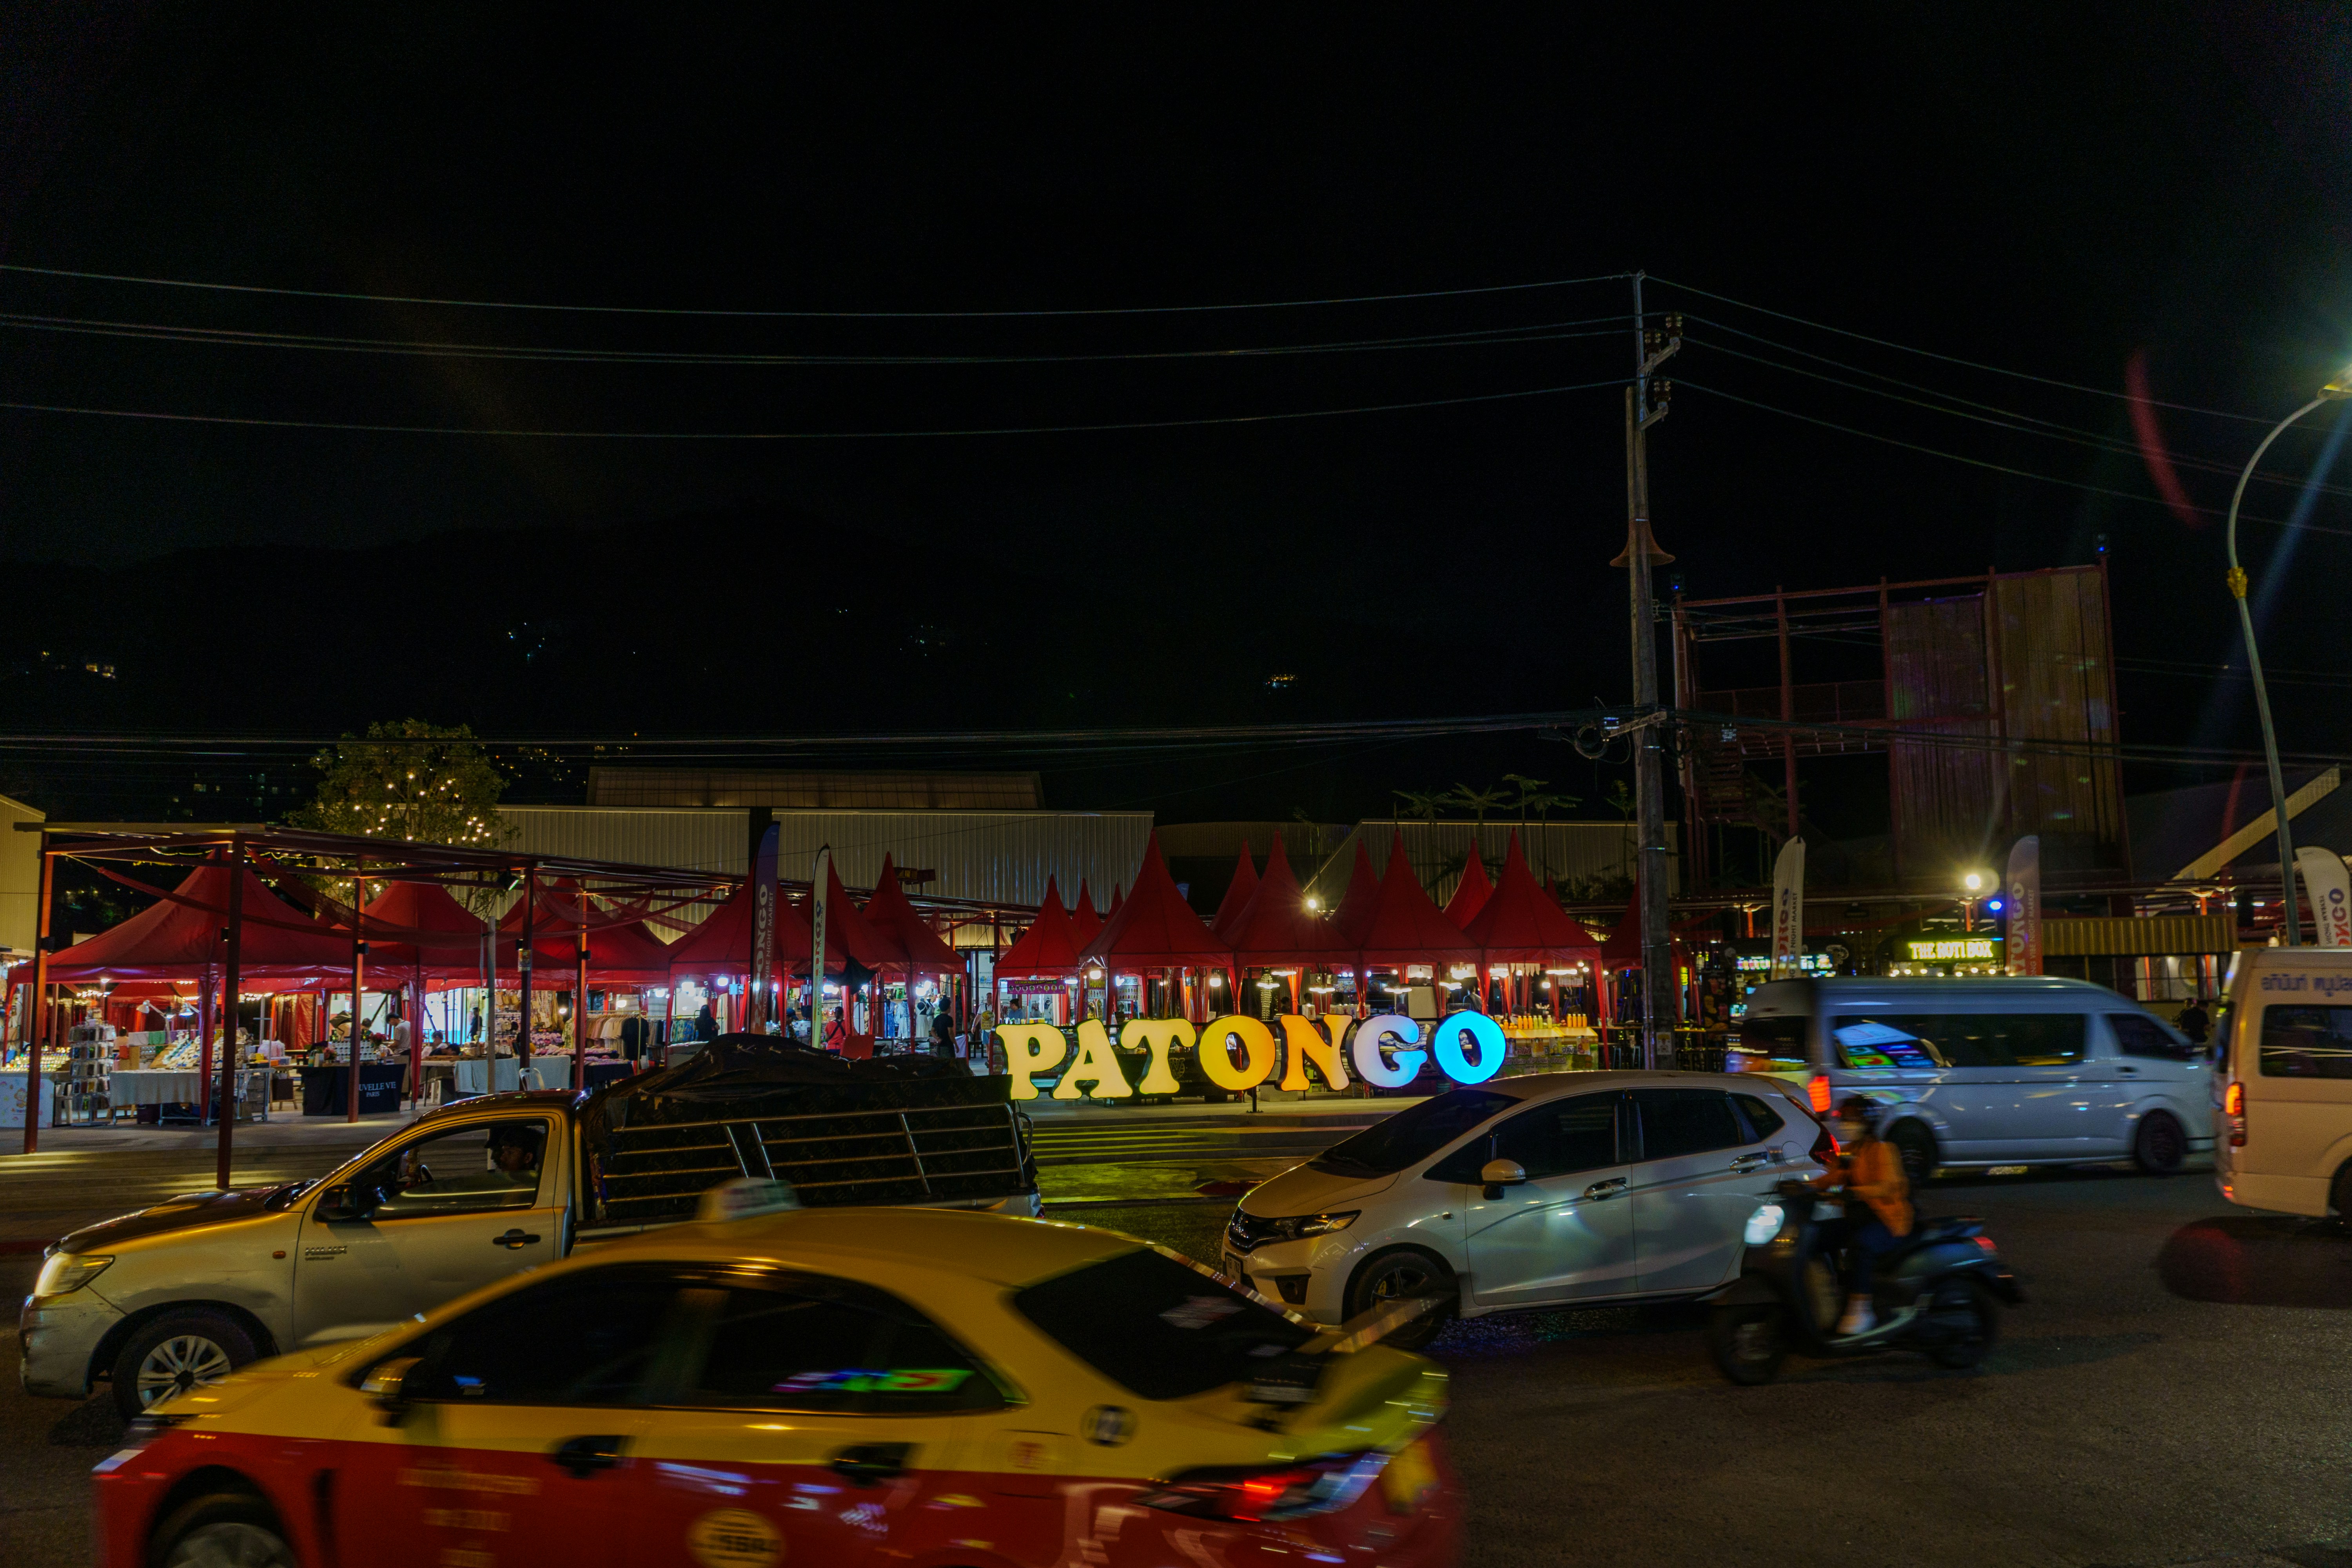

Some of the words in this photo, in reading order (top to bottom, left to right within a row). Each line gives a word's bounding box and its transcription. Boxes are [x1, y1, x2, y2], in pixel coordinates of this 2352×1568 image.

[1908, 942, 1936, 959] THE
[1936, 942, 1965, 959] ROTI
[1966, 941, 1994, 958] BOX
[993, 1010, 1506, 1100] PATONGO
[359, 1083, 385, 1091] UVELLE
